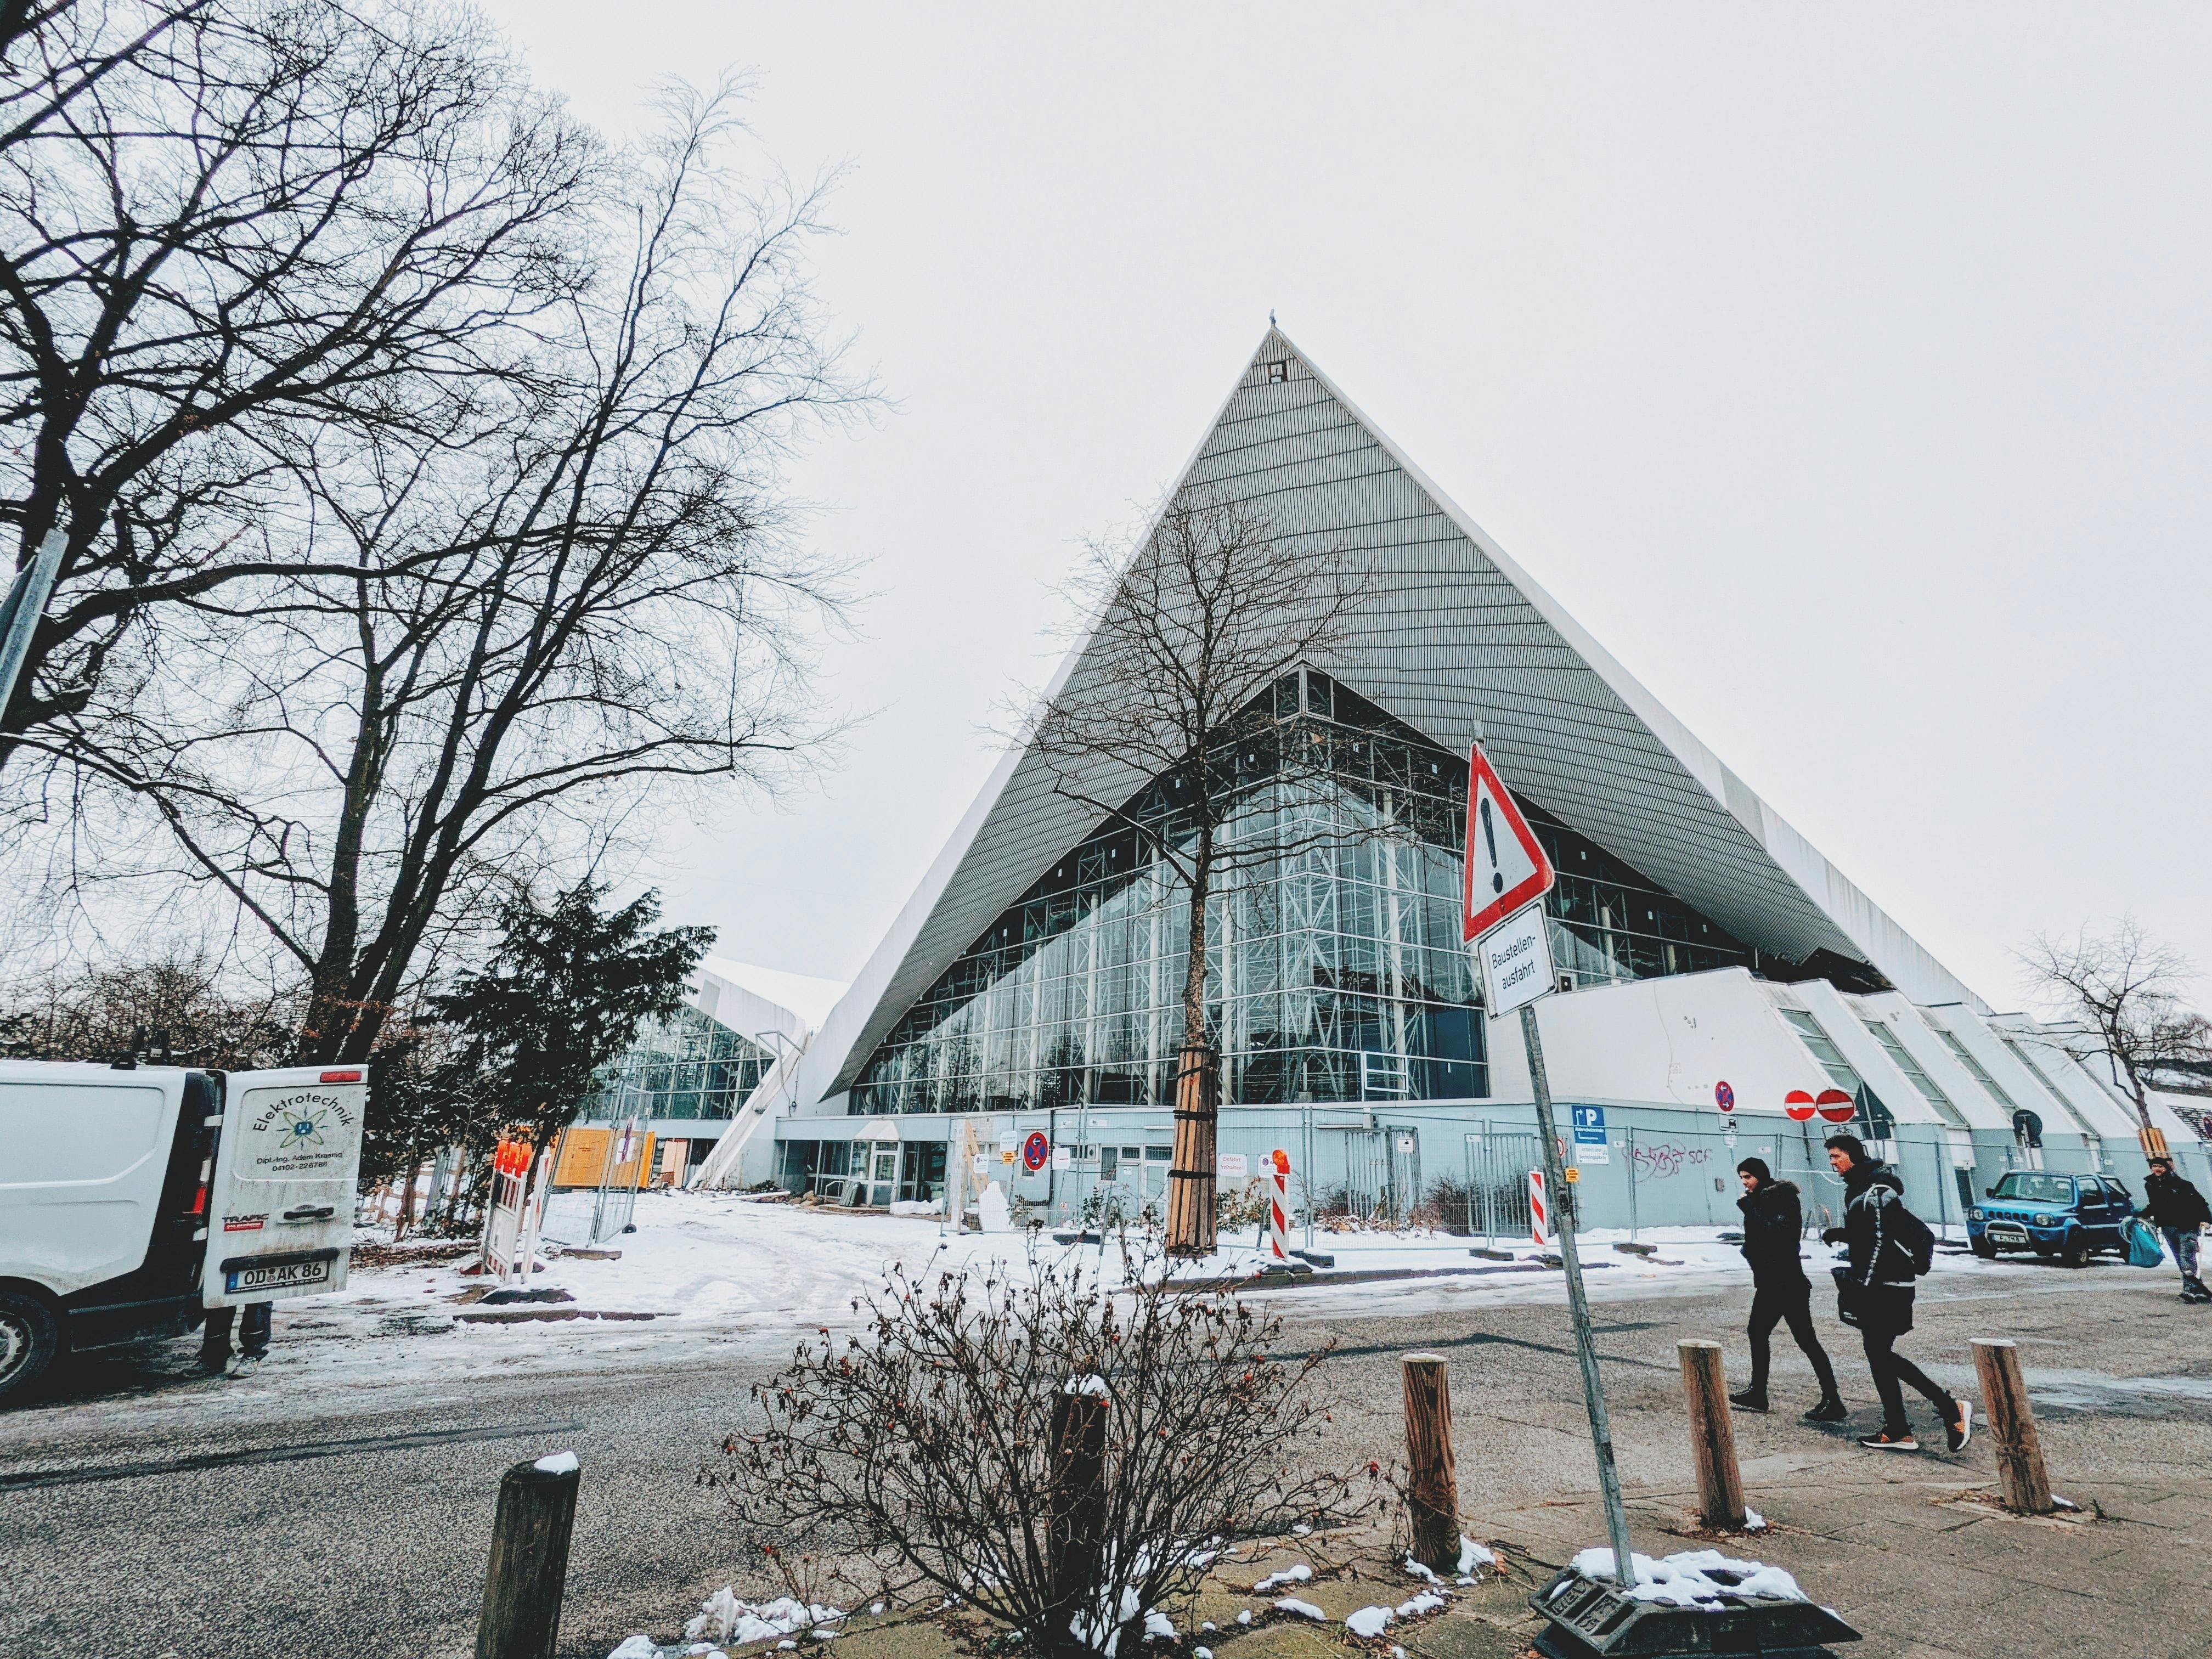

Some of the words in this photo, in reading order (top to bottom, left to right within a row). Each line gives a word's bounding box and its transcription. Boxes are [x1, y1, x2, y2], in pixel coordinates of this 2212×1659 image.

[1492, 935, 1536, 969] Baustellen-
[1502, 959, 1535, 990] ausfahrt
[252, 1092, 354, 1131] Elektrotechnik
[1585, 1109, 1597, 1126] P
[245, 1269, 266, 1285] OD
[277, 1265, 299, 1281] AK
[302, 1263, 321, 1277] 86
